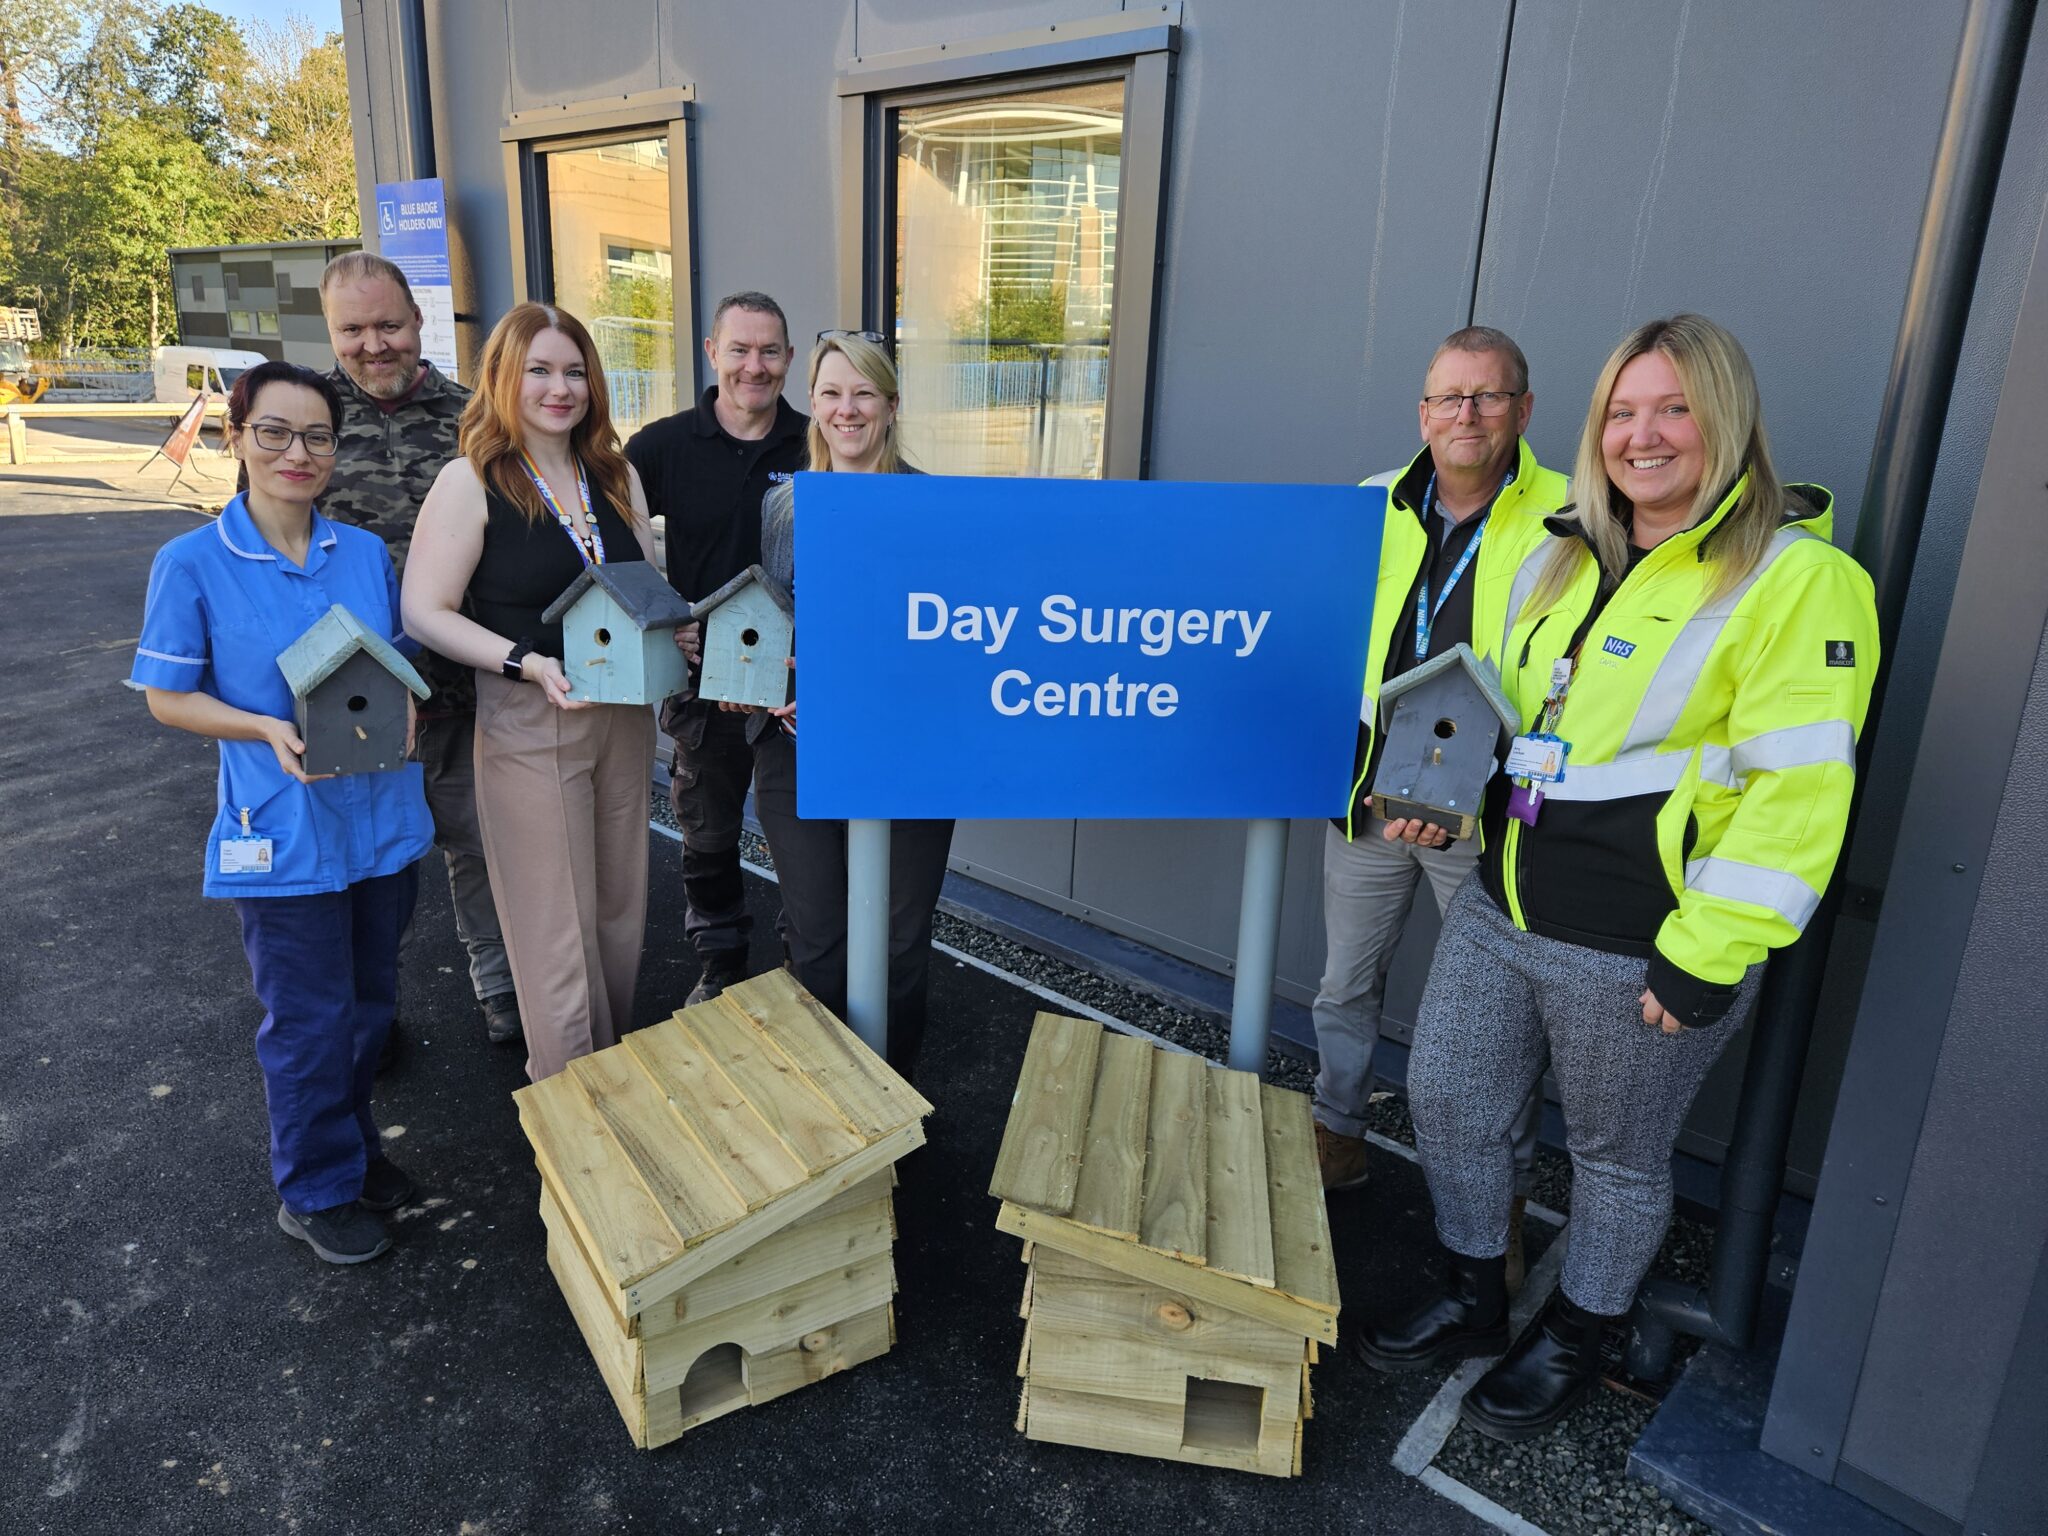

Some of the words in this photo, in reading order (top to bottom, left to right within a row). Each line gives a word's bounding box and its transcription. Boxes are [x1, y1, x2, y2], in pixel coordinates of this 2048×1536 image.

[401, 203, 416, 215] BLUE
[416, 201, 438, 214] BADGE
[399, 218, 426, 230] HOLDERS
[426, 217, 442, 229] ONLY
[533, 477, 555, 499] NHS
[577, 480, 590, 503] NHS
[591, 533, 604, 558] NHS
[1469, 535, 1482, 554] NHS
[1455, 556, 1469, 575] NHS
[1418, 585, 1427, 603] NHS
[1444, 577, 1457, 595] NHS
[907, 592, 1018, 654] Day
[1038, 595, 1271, 657] Surgery
[1416, 608, 1426, 627] NHS
[1604, 637, 1634, 656] NHS
[991, 669, 1179, 717] Centre
